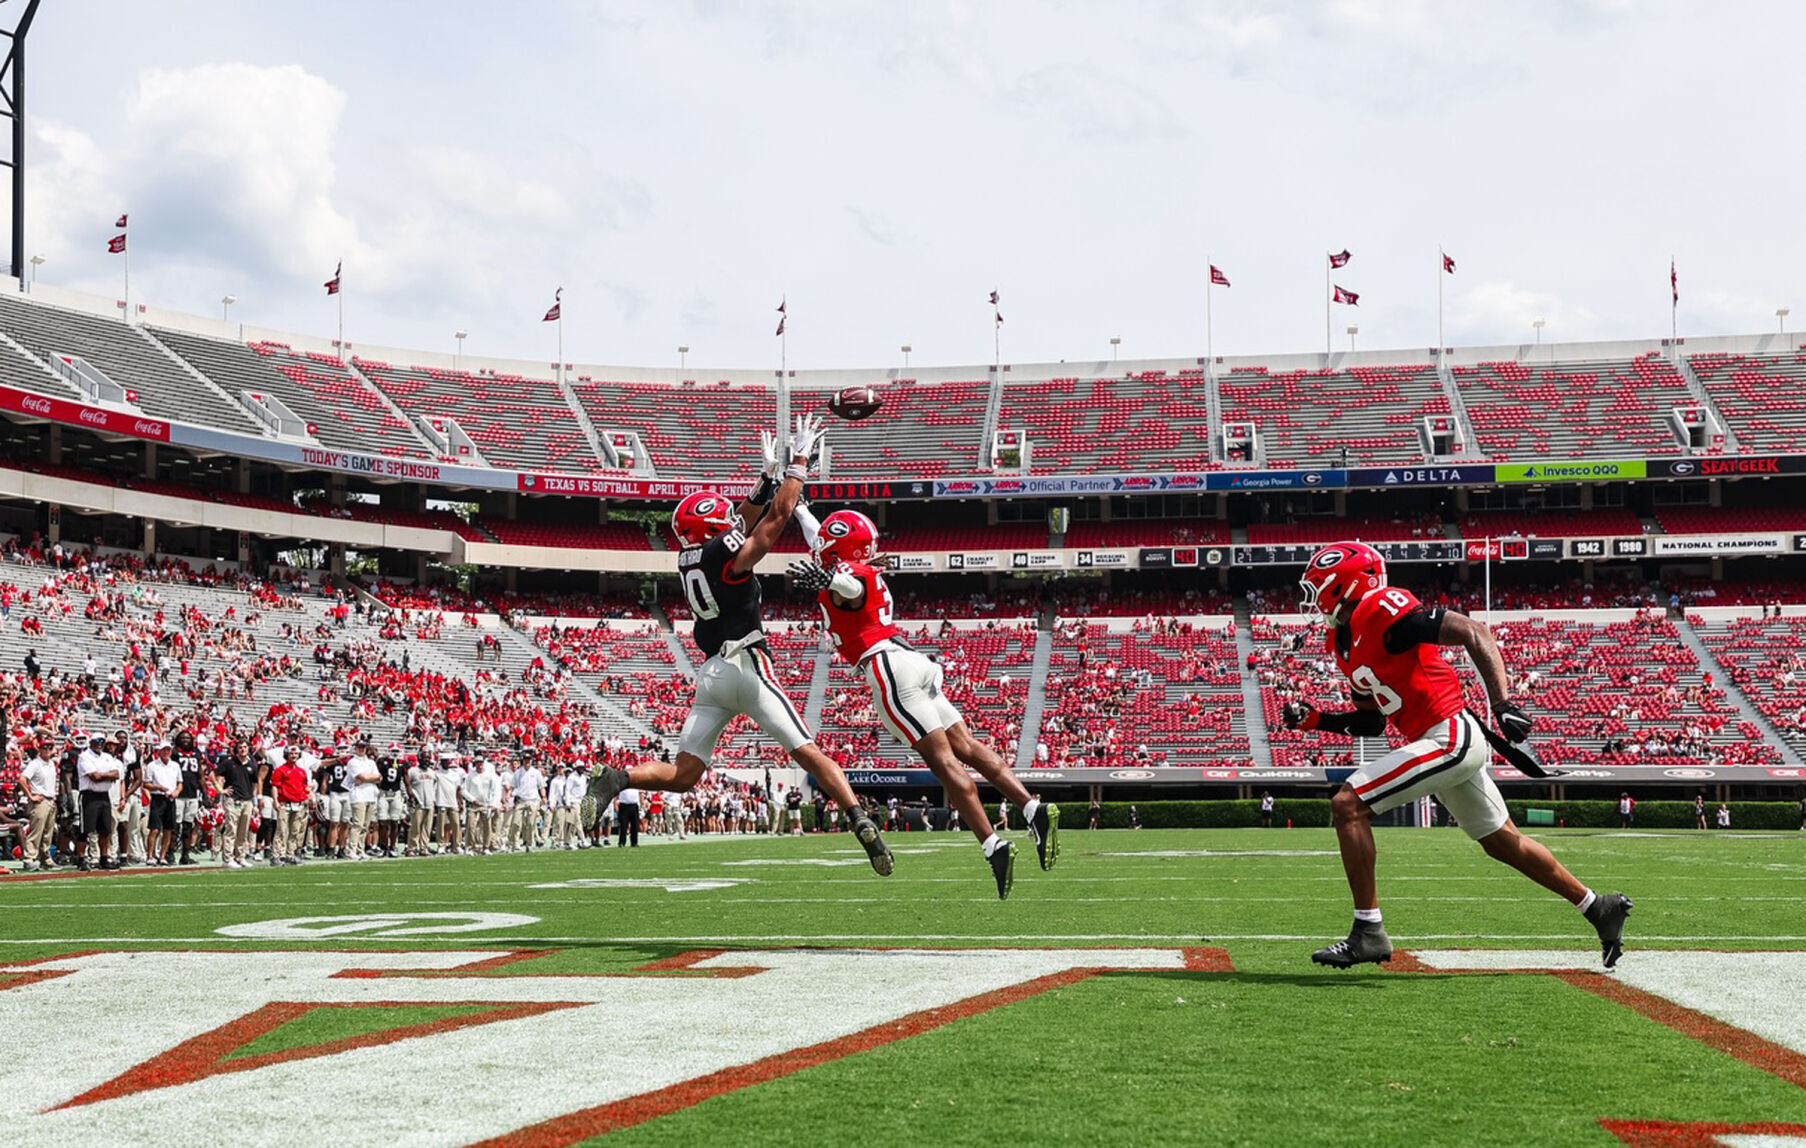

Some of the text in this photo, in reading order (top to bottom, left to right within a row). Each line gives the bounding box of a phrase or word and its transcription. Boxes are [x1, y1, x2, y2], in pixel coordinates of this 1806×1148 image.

[302, 448, 440, 481] TODAY'S GAME SPONSOR
[1543, 464, 1619, 477] Invesco QQQ
[1242, 477, 1293, 488] Georgia Power
[1403, 469, 1461, 482] DELTA
[544, 478, 640, 494] TEXAS VS SOFTBALL
[648, 483, 678, 496] APRIL
[809, 483, 892, 499] GEORGIA
[1029, 478, 1111, 493] Official Partner
[827, 521, 849, 537] G
[723, 529, 746, 552] 80
[1577, 542, 1600, 553] 1942
[1619, 541, 1642, 553] 1980
[1662, 540, 1778, 550] NATIONAL CHAMPIONS
[1175, 550, 1195, 563] 40
[1505, 542, 1525, 558] 40
[1316, 550, 1343, 569] G
[1379, 590, 1410, 617] 18
[388, 768, 398, 782] 9
